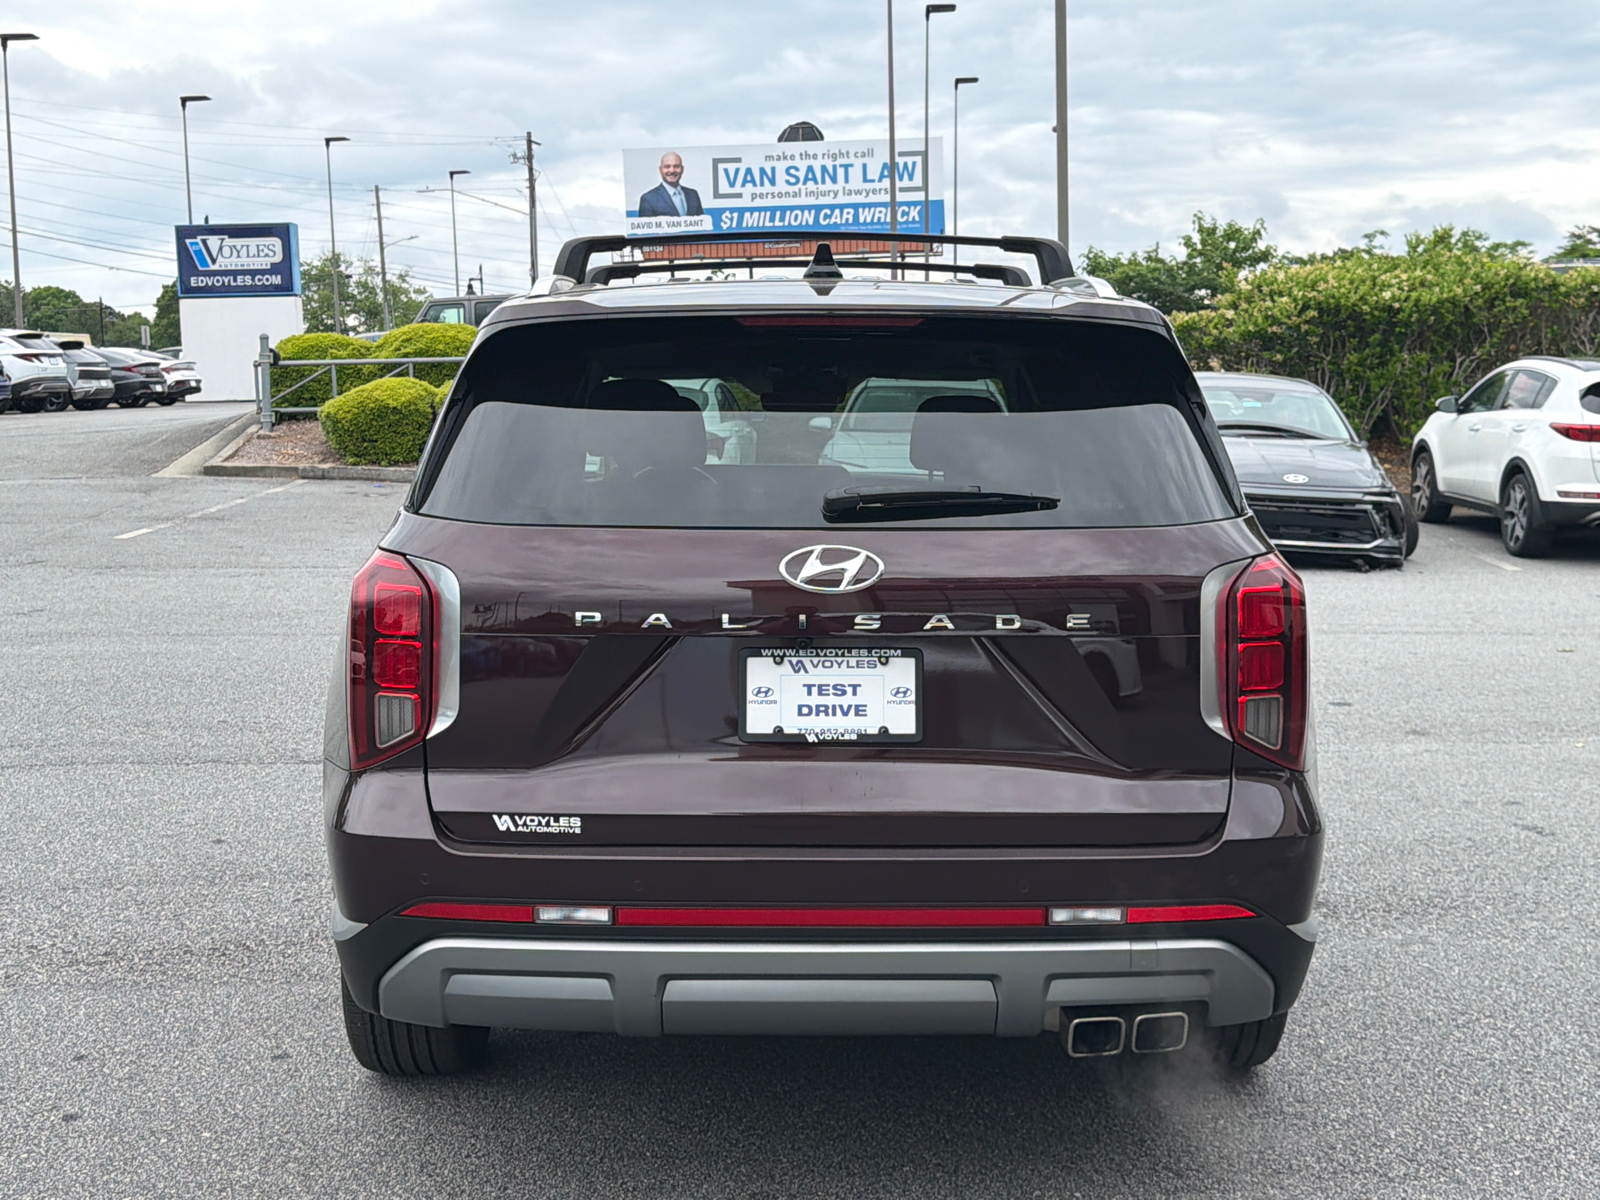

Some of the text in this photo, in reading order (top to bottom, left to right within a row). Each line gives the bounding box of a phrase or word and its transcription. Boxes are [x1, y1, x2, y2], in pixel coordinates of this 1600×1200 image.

[765, 148, 874, 162] make the right call
[723, 161, 917, 188] VAN SANT LAW
[751, 185, 889, 202] personal injury lawyers
[631, 219, 704, 230] DAVID M. VAN SANT
[720, 210, 738, 230] $1
[742, 209, 815, 228] MILLION
[819, 207, 854, 226] CAR
[200, 238, 276, 265] VOYLES
[190, 274, 282, 287] EDVOYLES.COM
[575, 611, 1092, 630] PALISADE
[761, 649, 902, 657] WWW.EDVOYLES.COM
[810, 659, 878, 669] VOYLES
[802, 683, 862, 697] TEST
[797, 704, 868, 717] DRIVE
[514, 815, 581, 827] VOYLES
[516, 826, 582, 834] AUTOMOTIVE
